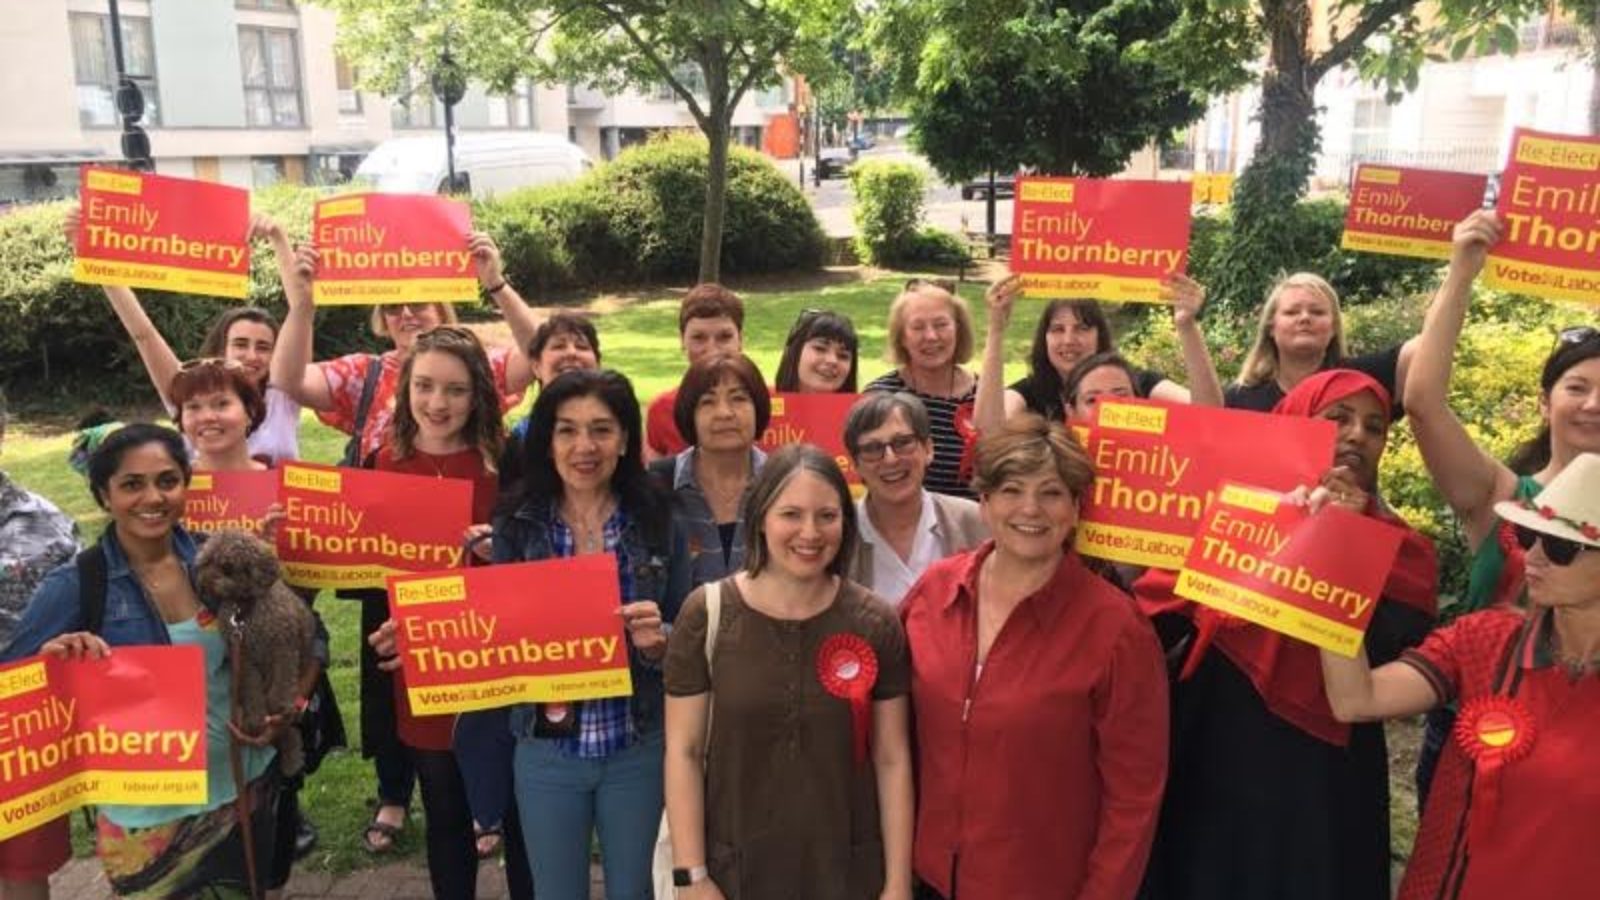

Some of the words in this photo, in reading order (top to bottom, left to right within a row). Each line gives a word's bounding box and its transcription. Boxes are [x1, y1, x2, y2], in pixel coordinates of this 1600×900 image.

[1358, 186, 1411, 213] Emily
[1512, 175, 1600, 217] Emil
[89, 197, 159, 232] Emily
[1021, 210, 1093, 242] Emily
[1353, 207, 1454, 233] Thornber
[86, 225, 245, 268] Thornberry
[320, 221, 386, 247] Emily
[82, 263, 115, 276] Vote
[319, 247, 471, 273] Thornberry
[1018, 238, 1182, 275] Thornberry
[1495, 264, 1541, 284] Vote
[1102, 408, 1162, 428] Re-Elect
[1096, 439, 1190, 487] Emily
[287, 471, 338, 489] Re-Elect
[185, 494, 230, 517] mily
[1094, 477, 1214, 519] Thorn
[287, 497, 363, 533] Emily
[1084, 528, 1124, 548] Vote
[1137, 537, 1184, 557] Labo
[1210, 510, 1290, 556] Emily
[285, 528, 463, 568] Thornberry
[287, 566, 320, 580] Vote
[1186, 575, 1220, 595] Vote
[1201, 536, 1372, 619] Thornberry
[399, 583, 463, 601] Re-Elect
[405, 609, 497, 643] Emily
[409, 636, 618, 673] Thornberry
[419, 691, 460, 706] Vote
[473, 683, 528, 700] Labour
[0, 724, 199, 783] Thornberry
[3, 799, 42, 824] Vote
